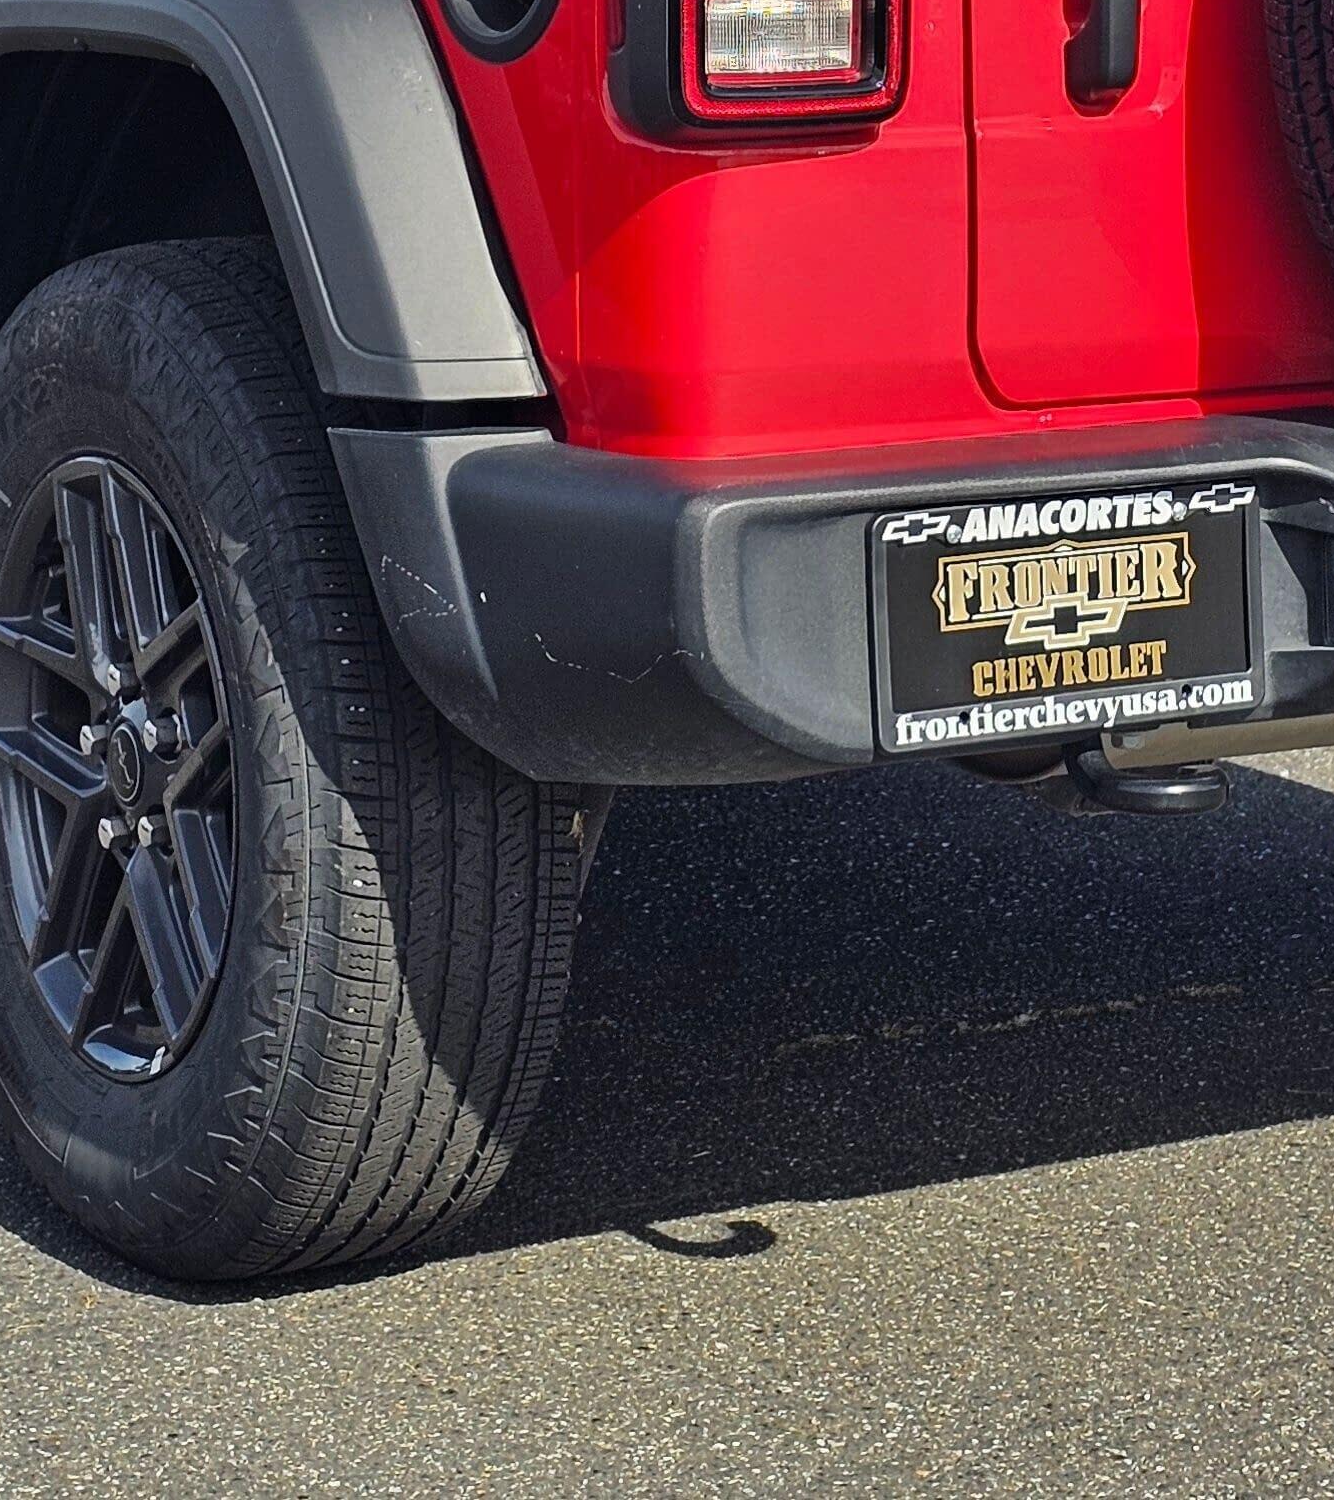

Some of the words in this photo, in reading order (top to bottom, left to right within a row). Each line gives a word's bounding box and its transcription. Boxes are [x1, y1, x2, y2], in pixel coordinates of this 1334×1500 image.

[960, 490, 1175, 543] ANACORTES
[945, 540, 1183, 623] FRONTIER
[971, 639, 1166, 697] CHEVROLET
[894, 677, 1254, 746] frontierchevyusa.com
